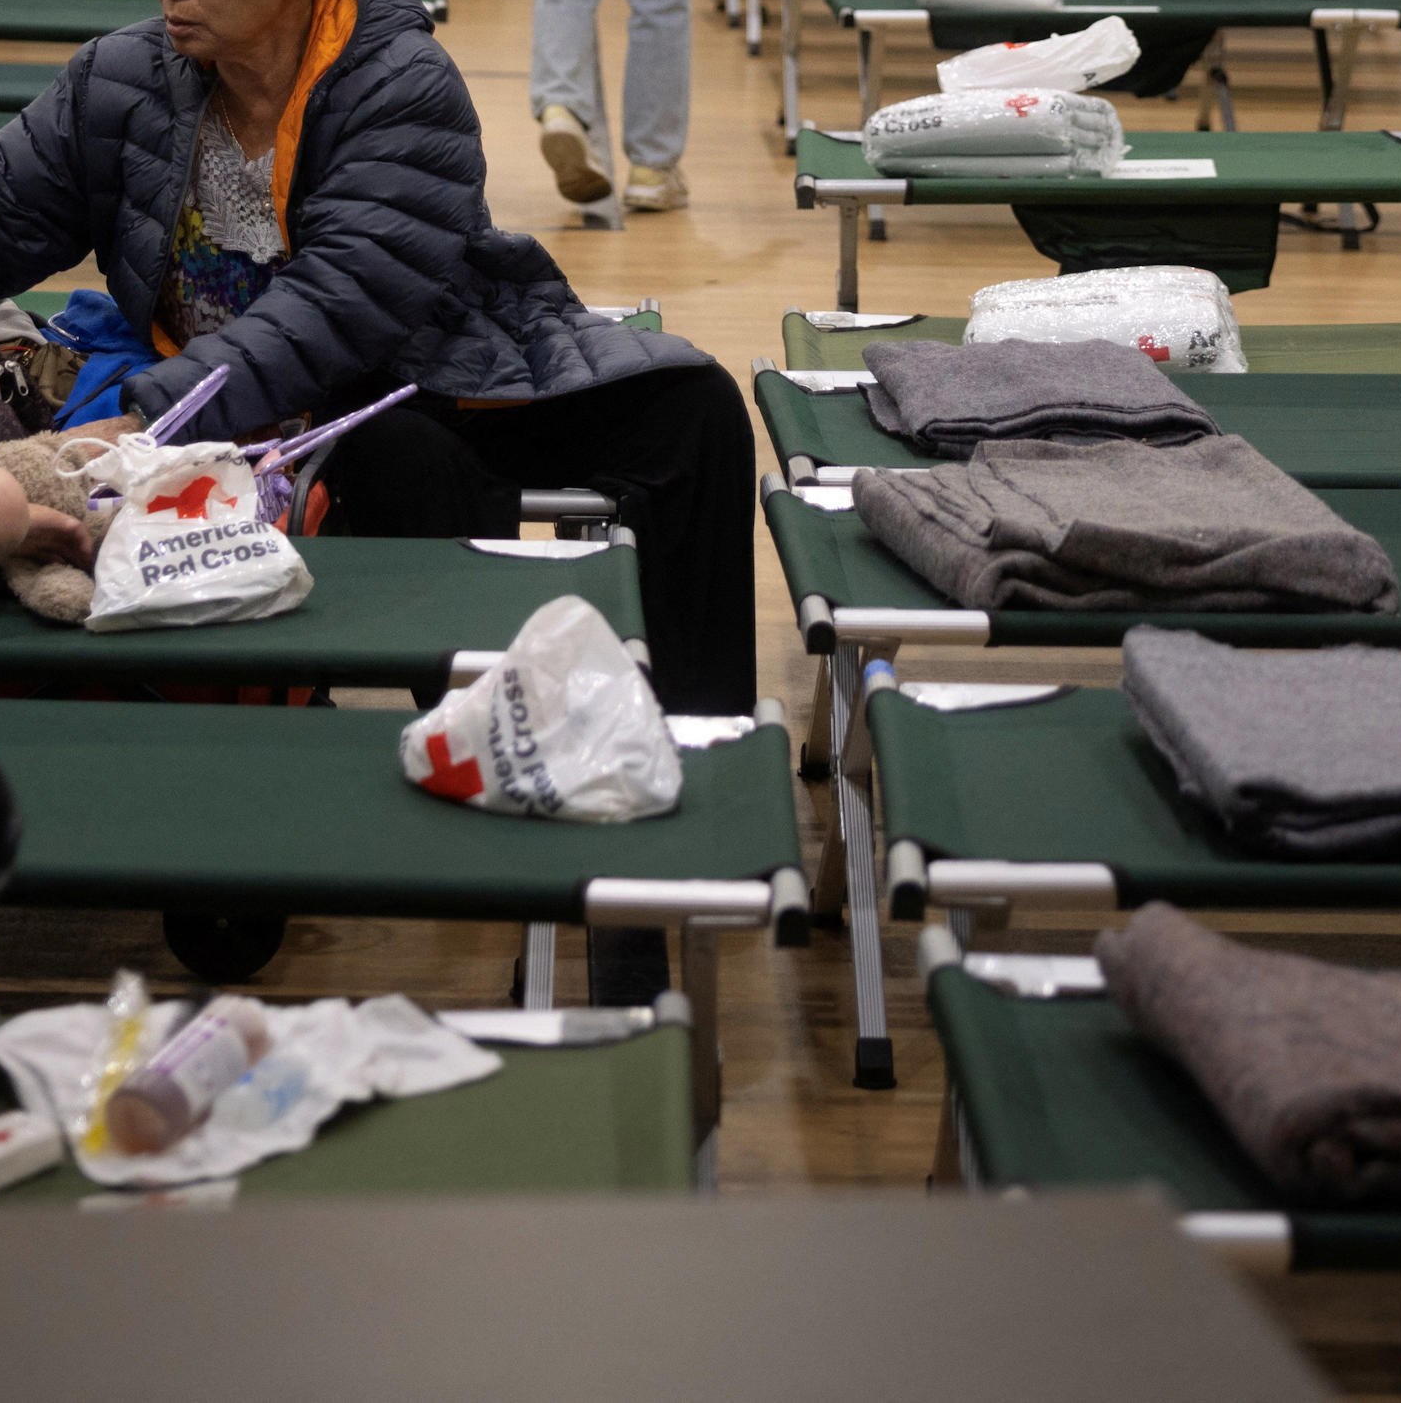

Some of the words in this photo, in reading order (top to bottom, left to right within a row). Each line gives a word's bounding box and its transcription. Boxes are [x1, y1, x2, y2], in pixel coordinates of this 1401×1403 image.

[138, 520, 270, 562] American
[141, 555, 197, 587] Red
[201, 539, 280, 570] Cross
[503, 668, 538, 759] Cross
